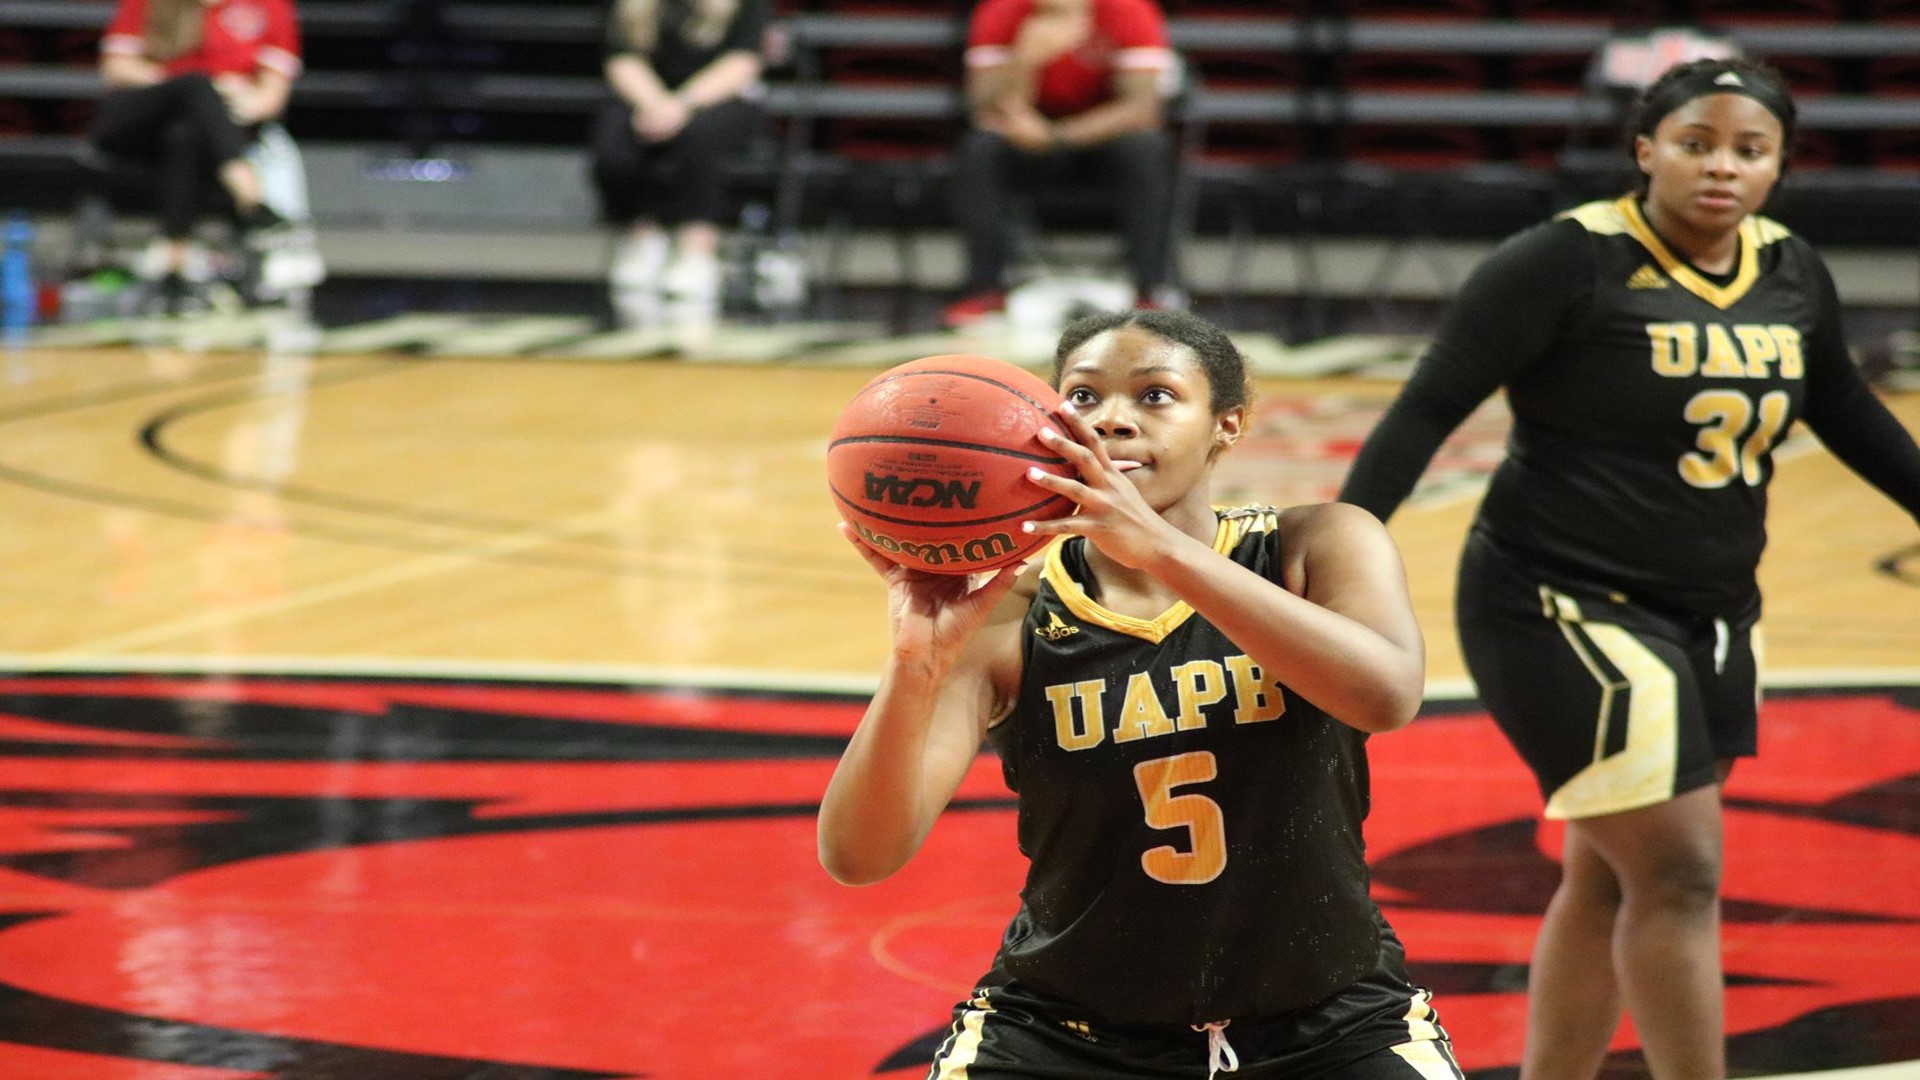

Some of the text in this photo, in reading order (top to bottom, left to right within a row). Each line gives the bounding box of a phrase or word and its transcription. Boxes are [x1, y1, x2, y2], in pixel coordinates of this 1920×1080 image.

[1645, 321, 1804, 379] UAPB
[1678, 389, 1791, 489] 31
[865, 471, 981, 509] NCAA
[851, 518, 1019, 565] Wilson
[1045, 654, 1286, 752] UAPB
[1133, 751, 1228, 885] 5
